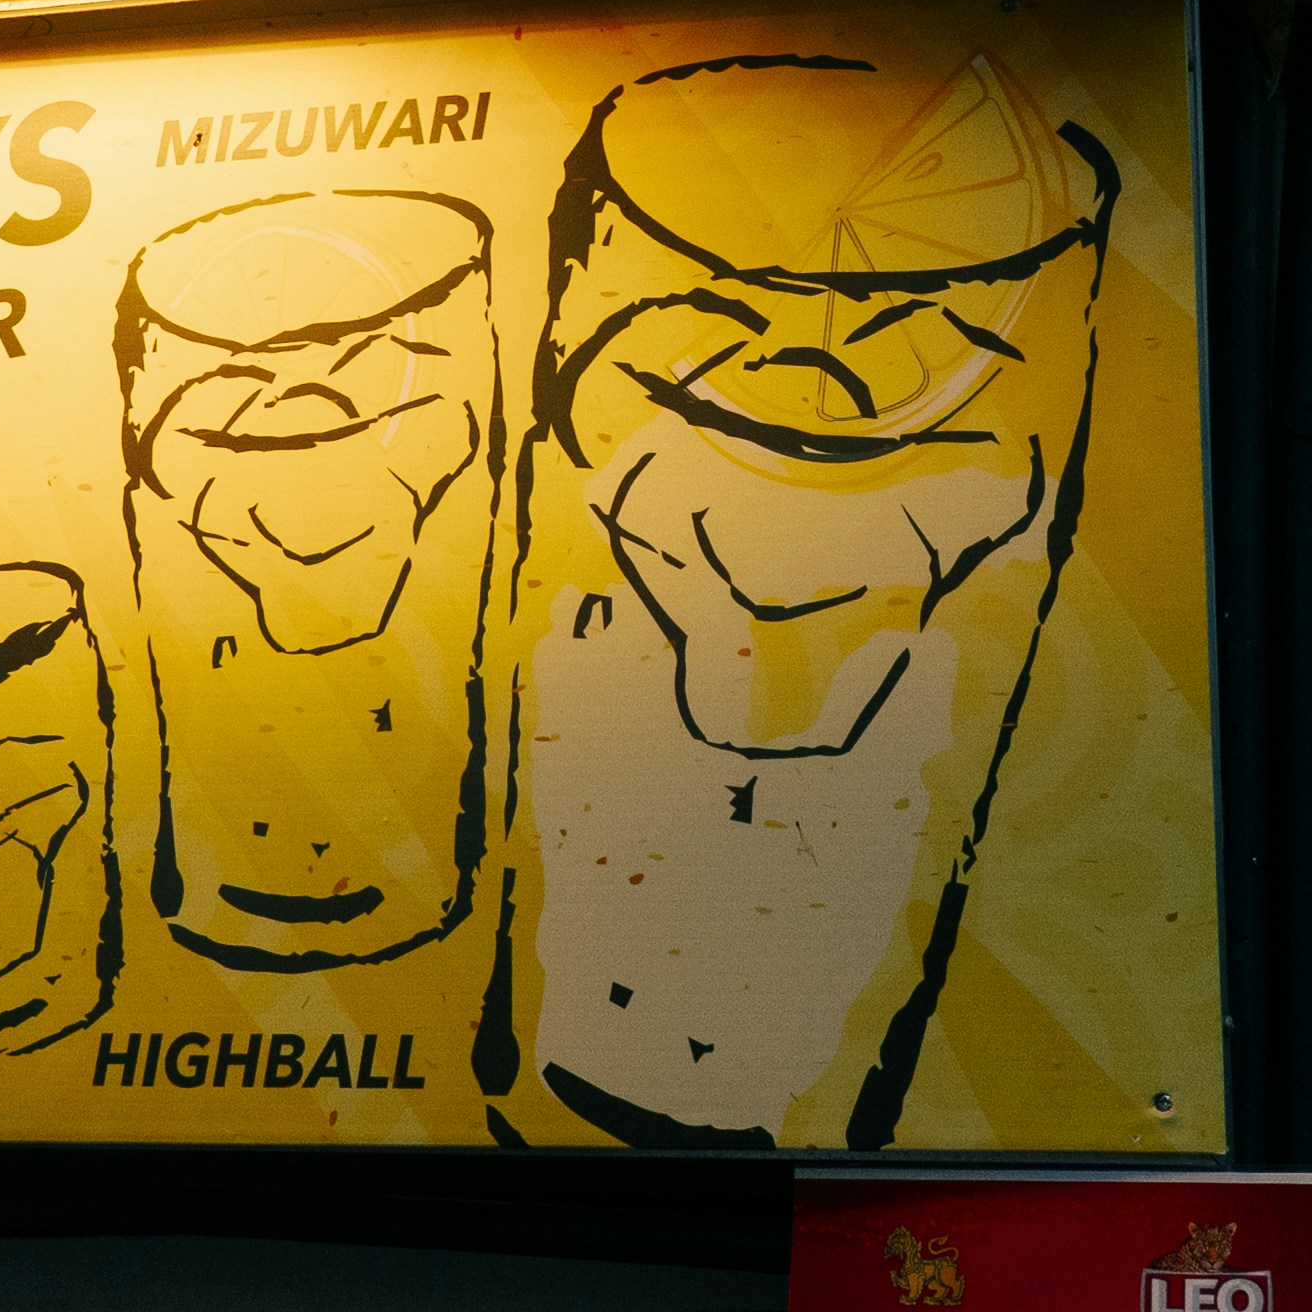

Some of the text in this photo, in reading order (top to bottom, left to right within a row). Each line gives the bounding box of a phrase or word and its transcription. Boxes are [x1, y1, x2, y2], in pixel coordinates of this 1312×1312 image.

[155, 91, 491, 168] MIZUWARI
[93, 1032, 426, 1090] HIGHBALL
[1150, 1277, 1265, 1312] LEO
